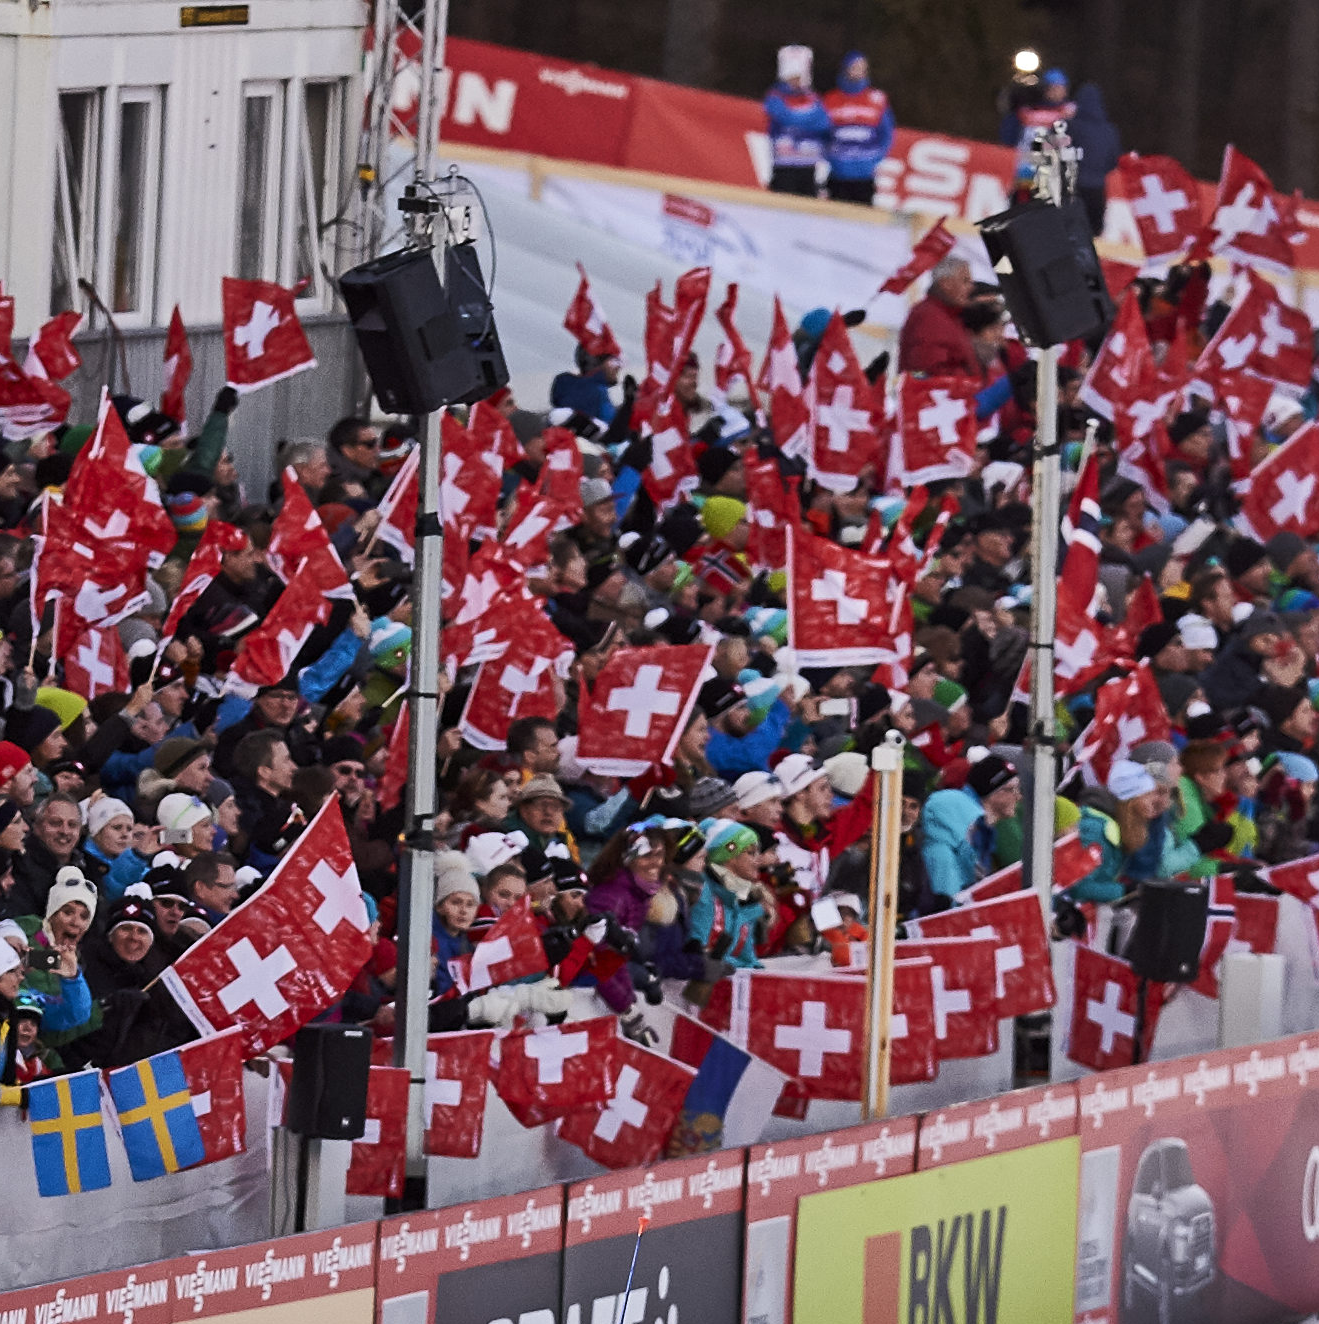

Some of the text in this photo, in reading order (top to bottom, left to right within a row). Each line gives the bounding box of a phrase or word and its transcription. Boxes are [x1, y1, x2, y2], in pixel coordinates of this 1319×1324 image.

[176, 1261, 237, 1312] VIESSMANN
[245, 1249, 305, 1300] VIESSMANN
[313, 1237, 372, 1288] VIESSMANN
